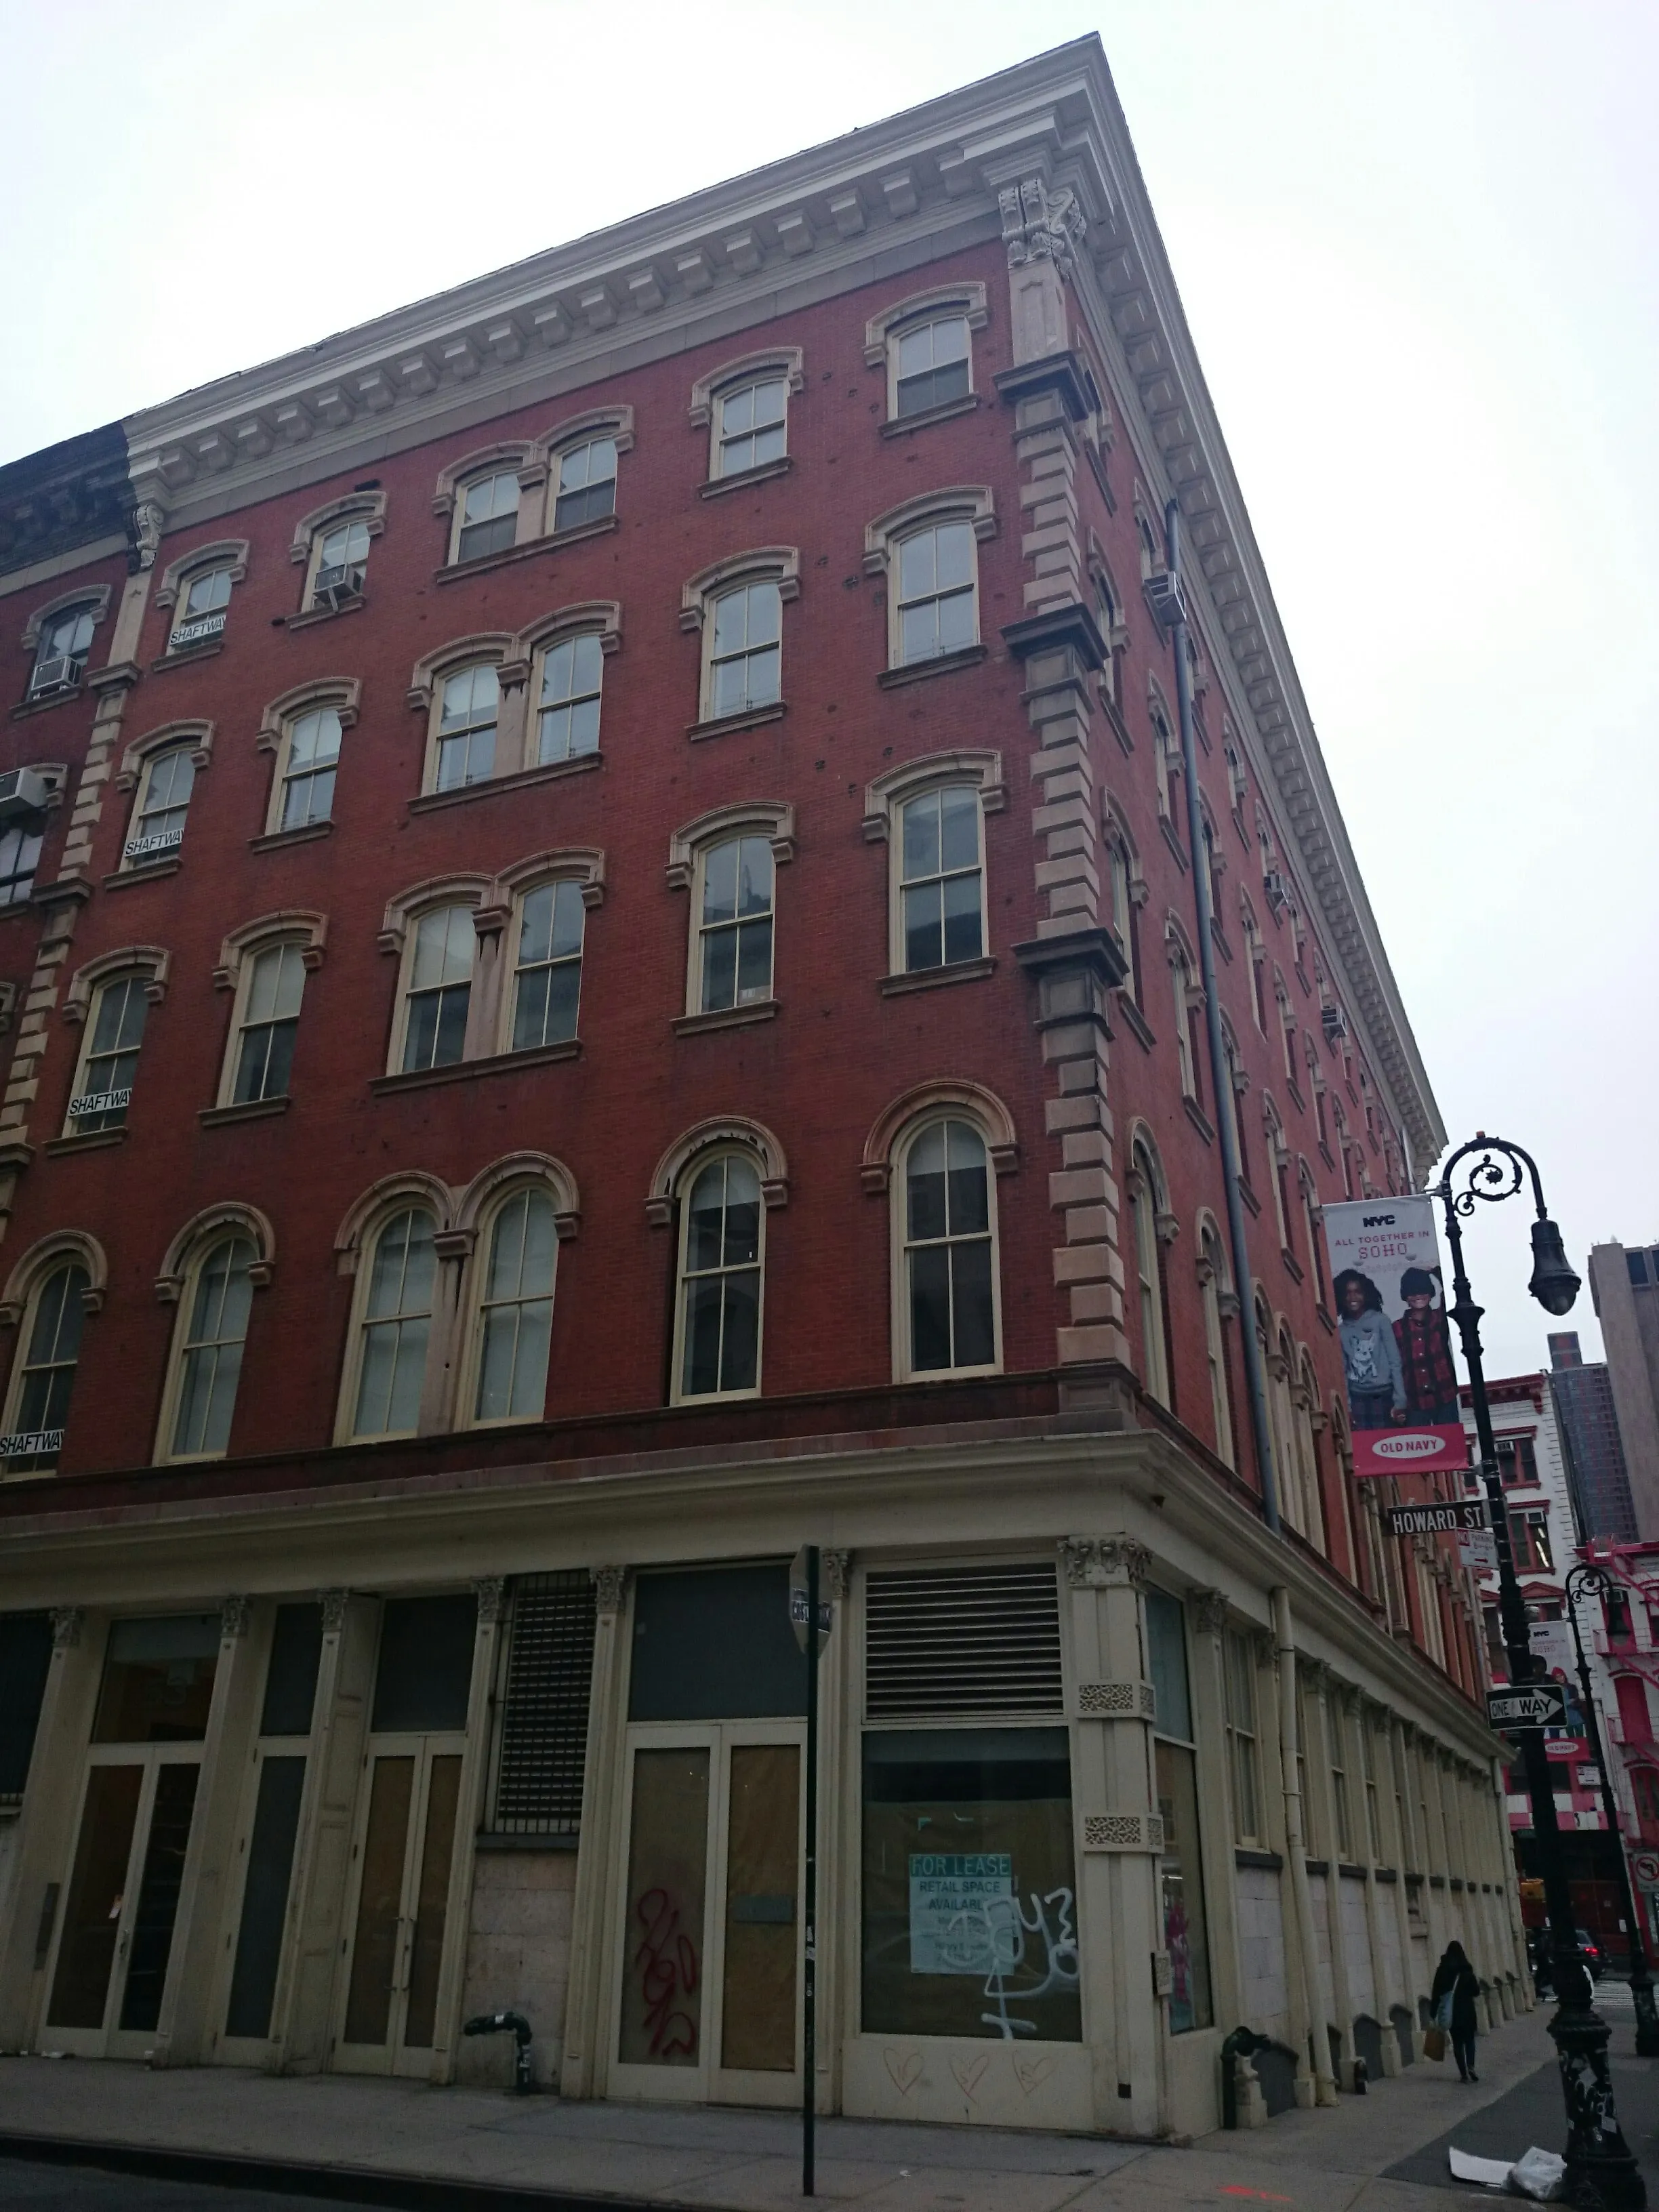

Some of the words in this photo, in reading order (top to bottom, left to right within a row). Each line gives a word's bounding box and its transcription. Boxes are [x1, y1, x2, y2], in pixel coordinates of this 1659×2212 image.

[1362, 1214, 1395, 1227] NYC
[1335, 1238, 1354, 1246] ALL
[1359, 1231, 1414, 1244] TOGETHER
[1359, 1242, 1407, 1259] SOHO
[1380, 1442, 1403, 1453] OLD
[1406, 1439, 1437, 1451] NAVY
[1393, 1509, 1456, 1534] HOWARD
[1464, 1507, 1481, 1528] ST
[1458, 1531, 1469, 1544] NO
[1492, 1700, 1510, 1717] ONE
[1518, 1698, 1552, 1714] WAY
[912, 1856, 946, 1875] FOR
[954, 1856, 1010, 1875] LEASE
[920, 1881, 959, 1893] RETAIL
[962, 1881, 1000, 1893] SPACE
[928, 1898, 987, 1910] AVAILABL
